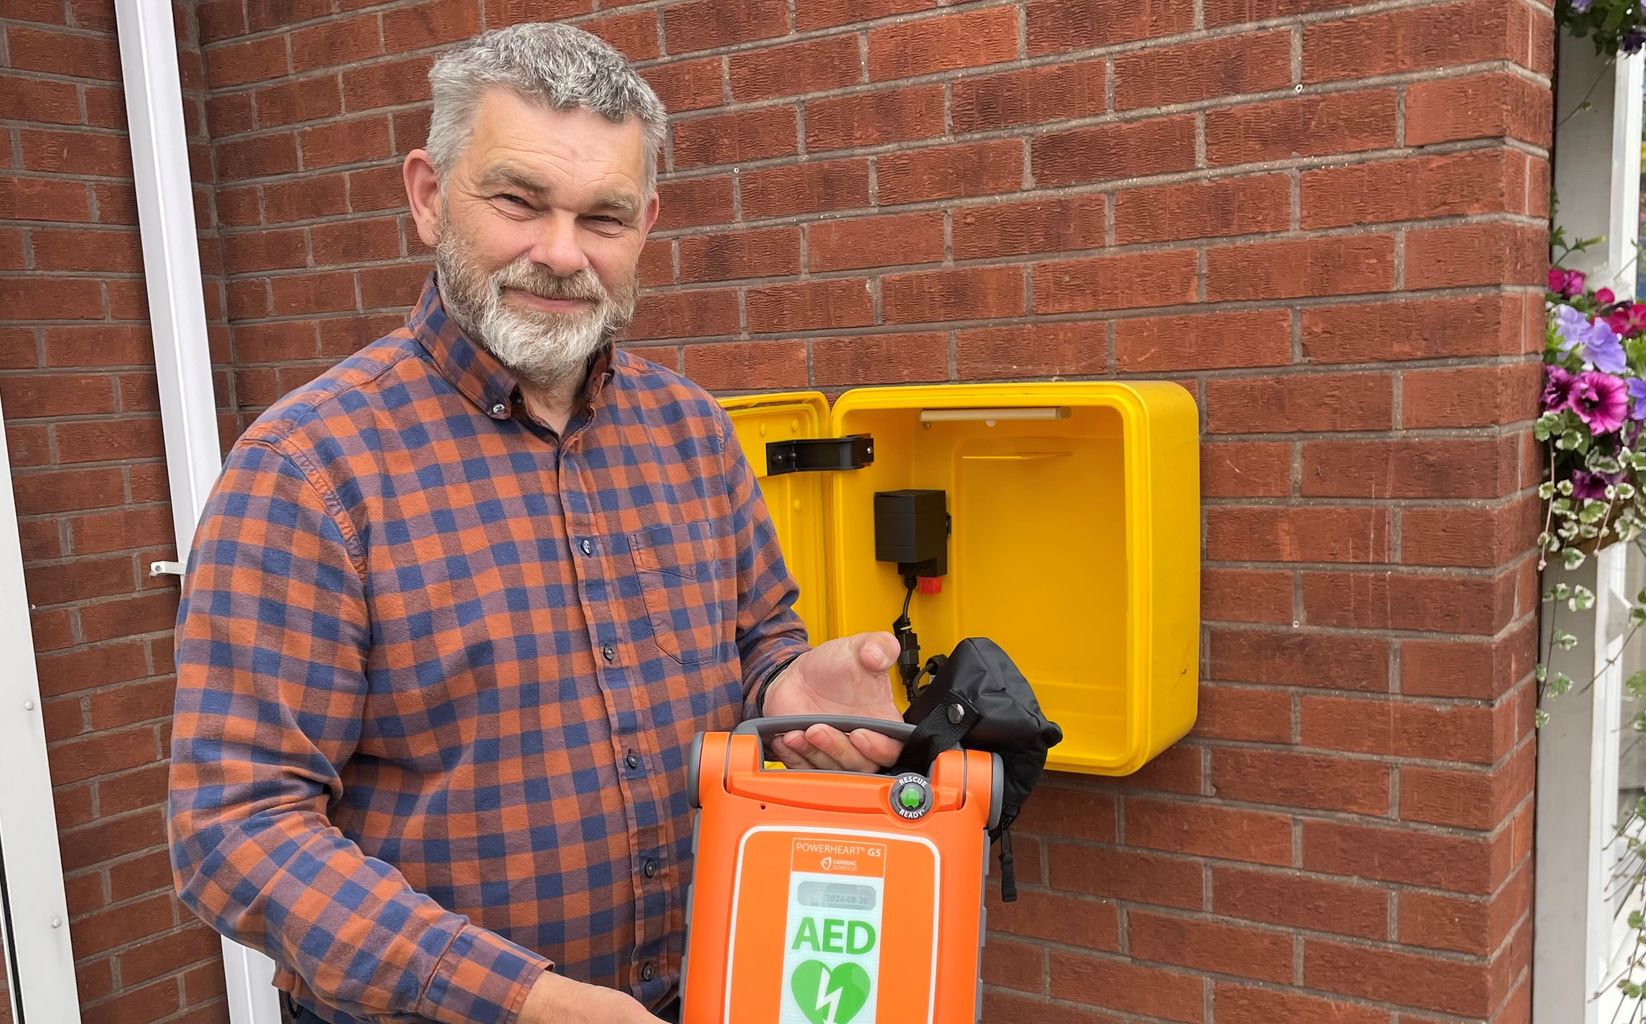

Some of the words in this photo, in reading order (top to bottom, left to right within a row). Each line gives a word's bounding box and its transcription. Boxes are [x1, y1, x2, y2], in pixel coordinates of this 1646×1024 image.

[898, 776, 928, 787] RESCUE
[867, 847, 881, 857] G5
[791, 916, 876, 954] AED
